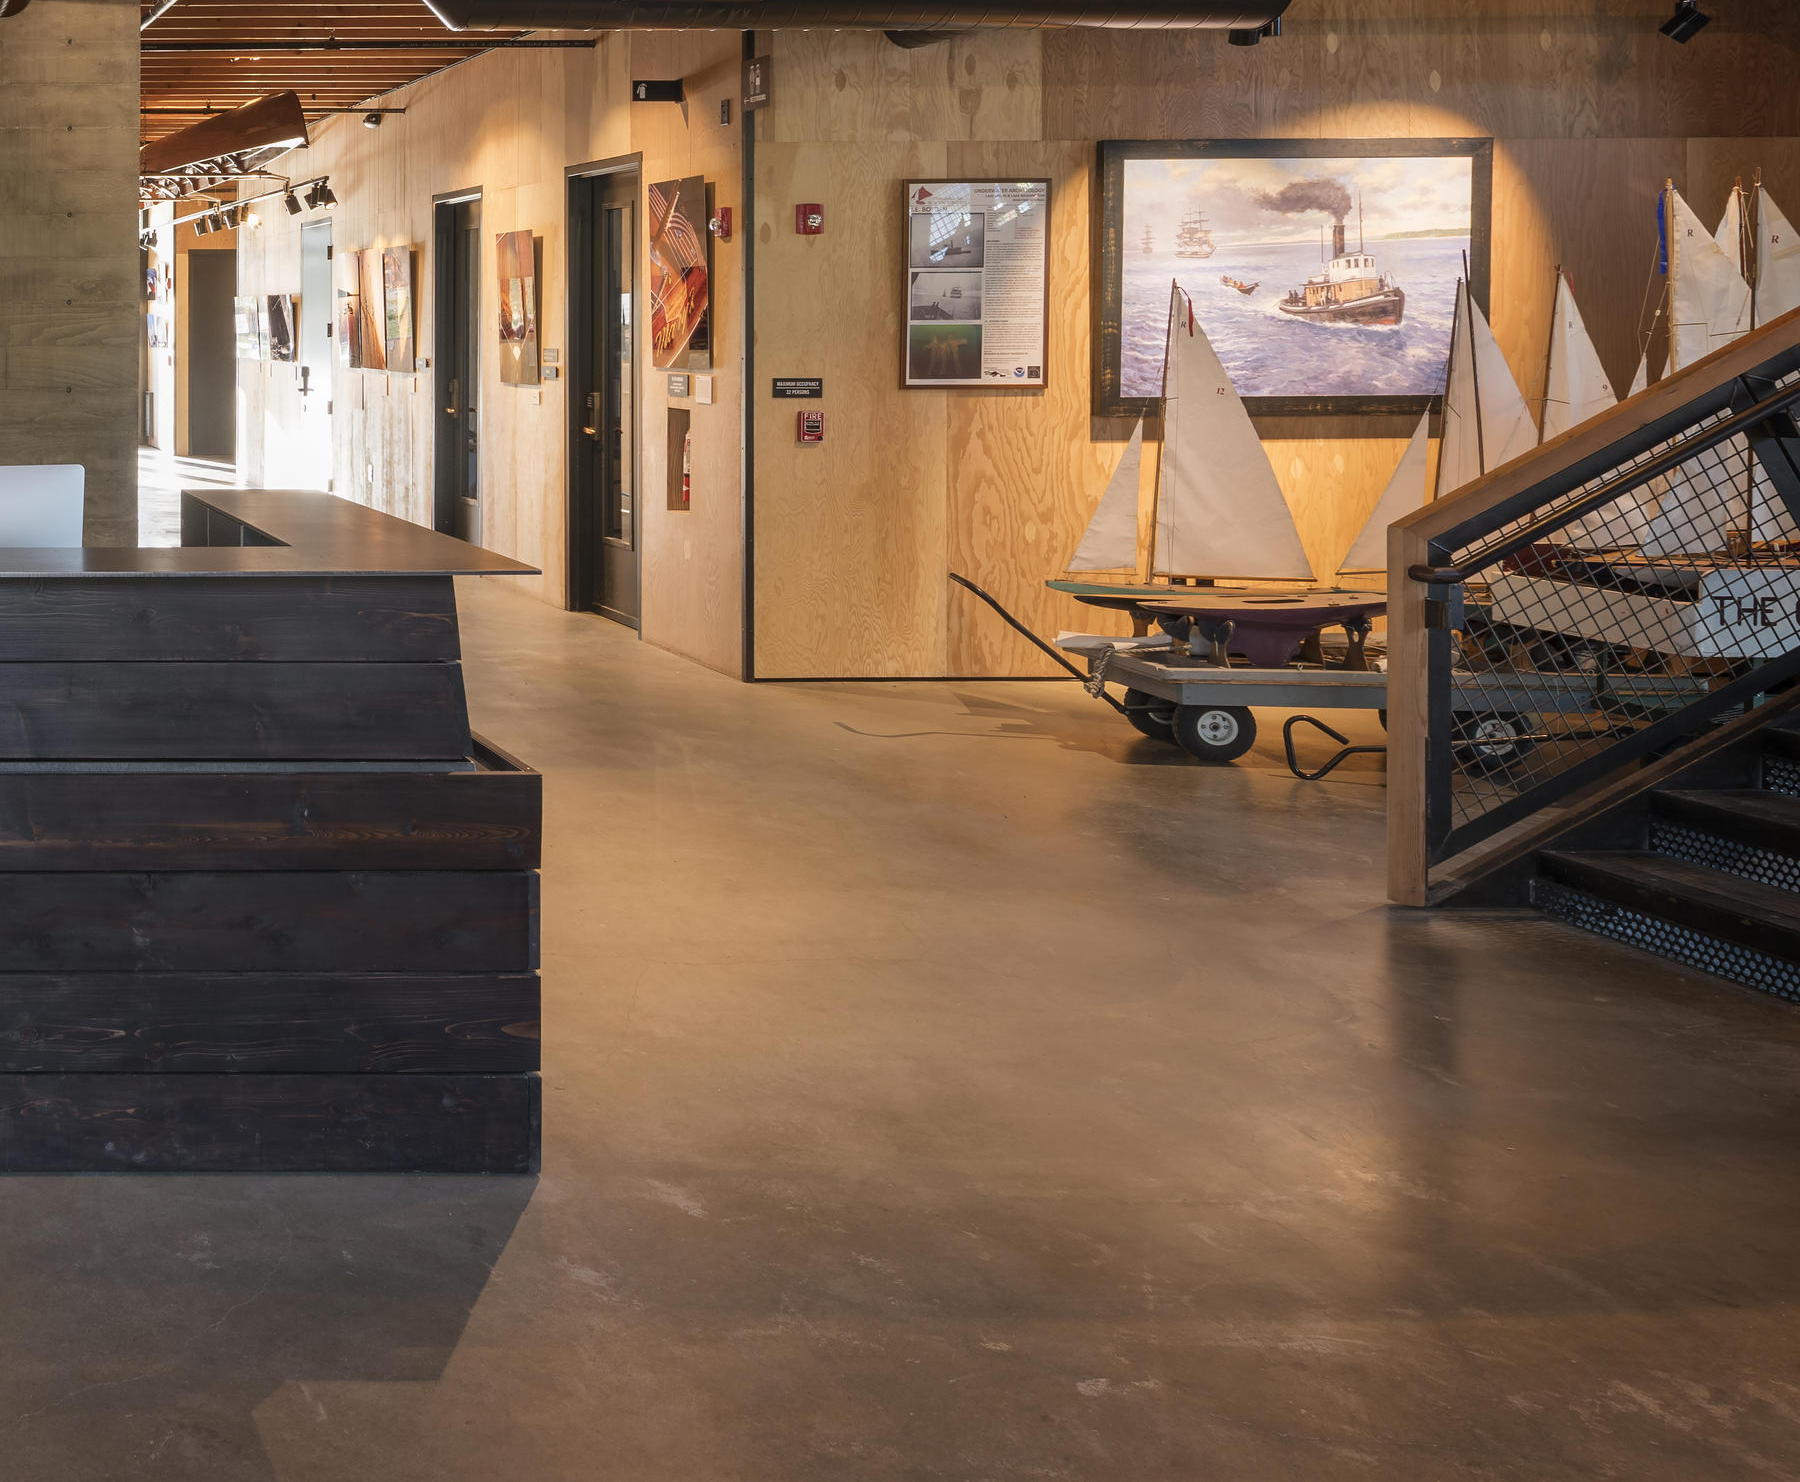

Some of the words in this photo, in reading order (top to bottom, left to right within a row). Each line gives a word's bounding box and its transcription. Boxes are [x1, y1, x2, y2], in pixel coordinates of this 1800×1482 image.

[1688, 229, 1694, 237] R
[1772, 235, 1779, 243] R
[1216, 387, 1225, 395] 12
[804, 412, 823, 420] FIRE
[1712, 595, 1779, 627] THE
